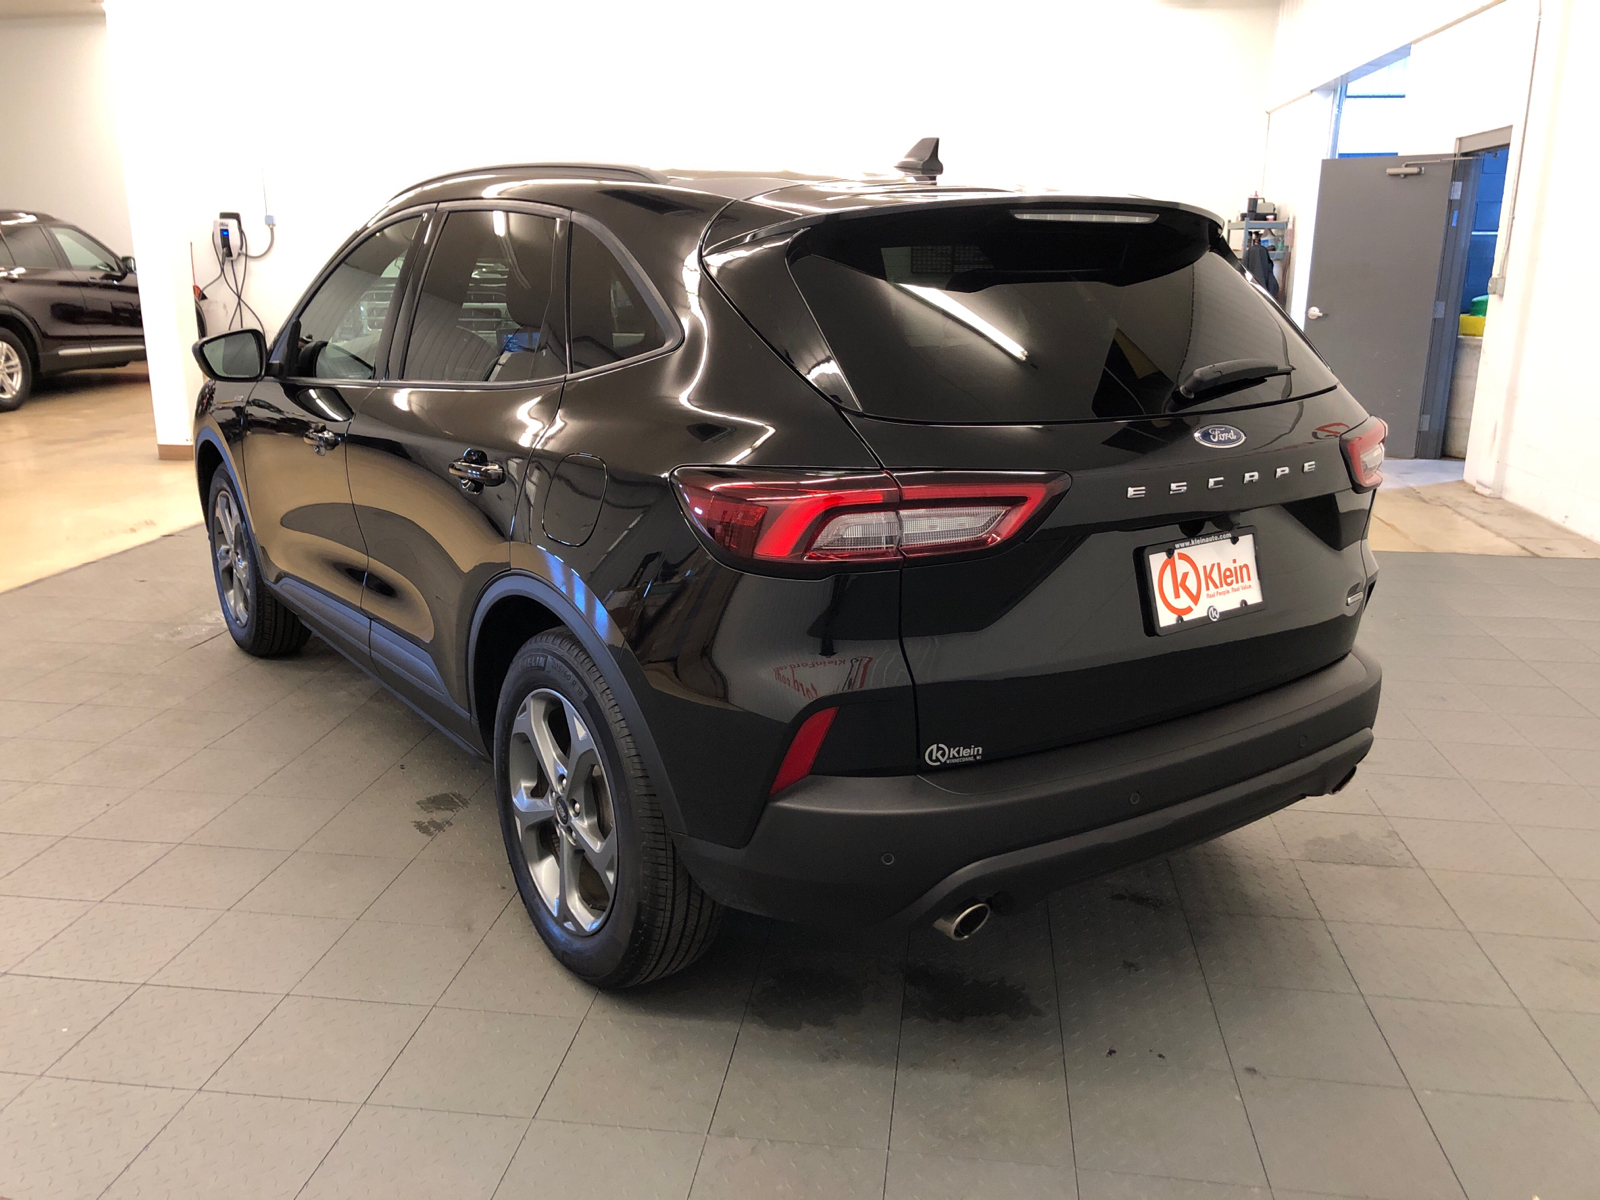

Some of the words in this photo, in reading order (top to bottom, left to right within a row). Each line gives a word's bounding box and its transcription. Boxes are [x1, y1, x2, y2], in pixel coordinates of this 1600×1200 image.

[1208, 427, 1238, 443] Ford
[1127, 461, 1316, 498] ESCAPE
[1174, 532, 1232, 549] www.kleinauto.com
[1202, 558, 1252, 592] Klein
[949, 745, 983, 758] Klein
